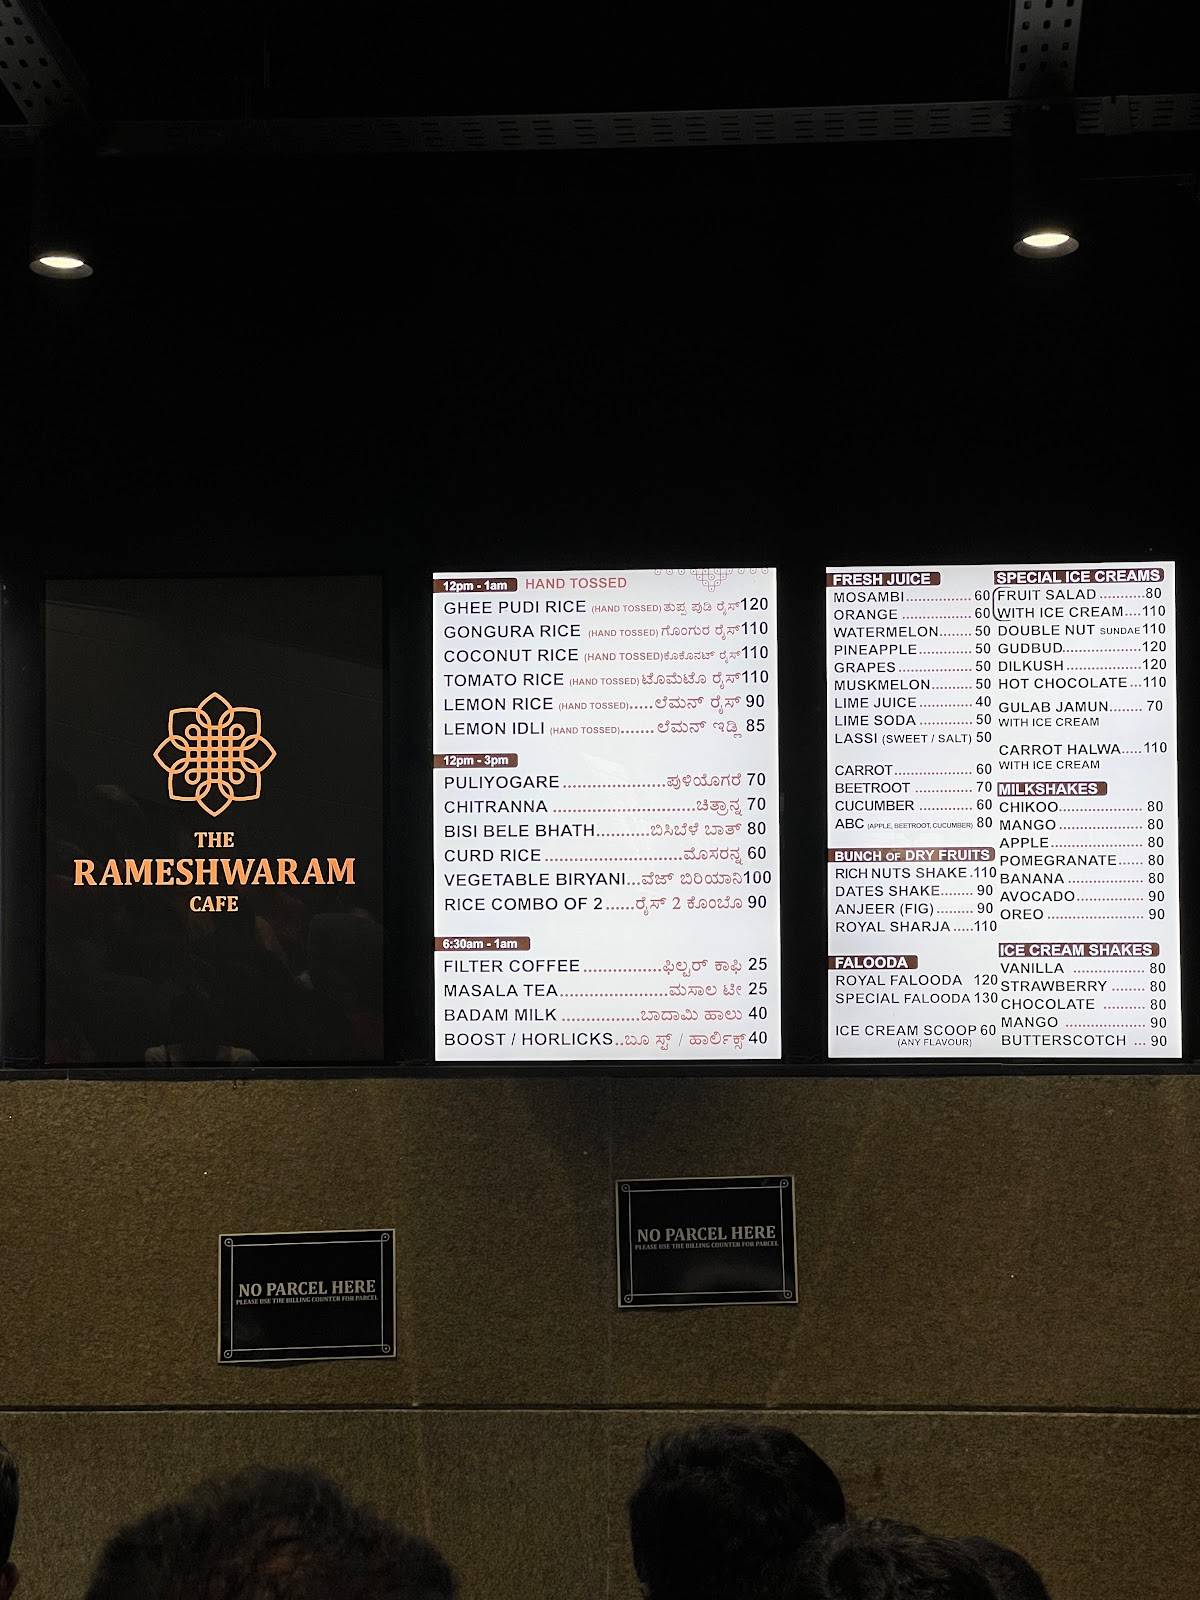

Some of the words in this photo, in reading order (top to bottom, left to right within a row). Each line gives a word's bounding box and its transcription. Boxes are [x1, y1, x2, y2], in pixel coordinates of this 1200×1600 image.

[833, 573, 883, 586] FRESH
[886, 573, 931, 585] JUICE
[996, 571, 1062, 583] SPECIAL
[1065, 571, 1090, 583] ICE
[1094, 570, 1161, 582] CREAMS
[443, 580, 474, 592] 12pm
[484, 580, 508, 592] 1am
[526, 578, 565, 590] HAND
[570, 578, 626, 589] TOSSED
[834, 592, 903, 603] MOSAMBI
[975, 590, 990, 601] 60
[997, 588, 1040, 601] FRUIT
[1046, 589, 1096, 601] SALAD
[1146, 588, 1161, 599] 80
[444, 602, 492, 615] GHEE
[499, 601, 538, 614] PUDI
[546, 601, 586, 613] RICE
[741, 598, 768, 611] 120
[444, 625, 534, 639] GONGURA
[541, 625, 580, 638] RICE
[742, 622, 768, 635] 110
[834, 627, 938, 638] WATERMELON
[975, 626, 990, 637] 50
[999, 625, 1060, 637] DOUBLE
[1066, 625, 1095, 636] NUT
[1100, 627, 1140, 635] SUNDAE
[1143, 623, 1165, 635] 110
[998, 643, 1064, 654] GUDBUD
[1143, 641, 1166, 652] 120
[445, 698, 505, 711] LEMON
[513, 698, 553, 711] RICE
[590, 702, 631, 710] TOSSED)
[746, 695, 764, 708] 90
[835, 698, 868, 709] LIME
[874, 697, 916, 709] JUICE
[976, 696, 991, 707] 40
[999, 702, 1050, 713] GULAB
[1056, 702, 1111, 713] JAMUN
[1147, 700, 1162, 712] 70
[998, 719, 1028, 728] WITH
[1033, 718, 1051, 727] ICE
[1056, 718, 1099, 727] CREAM
[835, 733, 876, 744] LASSI
[882, 733, 928, 745] (SWEET
[938, 733, 972, 744] SALT)
[977, 732, 991, 743] 50
[443, 755, 474, 766] 12pm
[484, 755, 509, 766] 3pm
[445, 776, 559, 790] PULIYOGARE
[747, 773, 765, 786] 70
[836, 783, 910, 794] BEETROOT
[977, 782, 992, 793] 70
[999, 783, 1098, 796] MILKSHAKES
[445, 800, 547, 814] CHITRANNA
[748, 798, 765, 811] 70
[1000, 802, 1060, 813] CHIKOO
[1148, 801, 1163, 812] 80
[835, 819, 864, 829] ABC
[977, 817, 992, 828] 80
[445, 825, 476, 838] BISI
[484, 825, 528, 838] BELE
[536, 824, 594, 837] BHATH
[748, 822, 766, 835] 80
[194, 832, 234, 847] THE
[834, 850, 882, 862] BUNCH
[904, 849, 936, 862] DRY
[939, 849, 990, 861] FRUITS
[1001, 855, 1116, 867] POMEGRANATE
[1148, 855, 1164, 866] 80
[74, 858, 355, 885] RAMESHWARAM
[836, 868, 867, 879] RICH
[872, 868, 910, 879] NUTS
[916, 868, 967, 879] SHAKE
[974, 867, 996, 879] 110
[444, 874, 549, 887] VEGETABLE
[557, 873, 624, 886] BIRYANI
[744, 871, 771, 884] 100
[190, 896, 238, 911] CAFE
[835, 904, 894, 915] ANJEER
[899, 902, 934, 917] (FIG)
[978, 903, 993, 914] 90
[1000, 909, 1043, 920] OREO
[1149, 909, 1164, 920] 90
[442, 938, 483, 950] 6:30am
[494, 938, 518, 950] 1am
[1000, 944, 1026, 958] ICE
[1029, 944, 1085, 957] CREAM
[1088, 943, 1152, 957] SHAKES
[445, 960, 503, 973] FILTER
[510, 960, 579, 973] COFFEE
[749, 958, 767, 971] 25
[834, 956, 908, 969] FALOODA
[1001, 963, 1064, 974] VANILLA
[1150, 963, 1165, 974] 80
[445, 985, 518, 997] MASALA
[523, 984, 558, 997] TEA
[749, 982, 767, 996] 25
[1001, 981, 1107, 992] STRAWBERRY
[1151, 981, 1166, 993] 80
[836, 993, 899, 1004] SPECIAL
[905, 994, 970, 1004] FALOODA
[975, 992, 998, 1004] 130
[445, 1009, 507, 1022] BADAM
[515, 1009, 556, 1022] MILK
[749, 1007, 767, 1020] 40
[836, 1026, 859, 1036] ICE
[865, 1025, 918, 1036] CREAM
[924, 1025, 976, 1036] SCOOP
[981, 1025, 996, 1036] 60
[445, 1033, 506, 1046] BOOST
[523, 1033, 612, 1046] HORLICKS
[749, 1031, 767, 1045] 40
[897, 1037, 921, 1047] (ANY
[923, 1037, 972, 1047] FLAVOUR)
[1002, 1035, 1125, 1046] BUTTERSCOTCH
[1151, 1036, 1167, 1047] 90
[638, 1229, 660, 1242] NO
[666, 1227, 727, 1241] PARCEL
[732, 1226, 775, 1239] HERE
[239, 1284, 262, 1297] NO
[267, 1281, 327, 1296] PARCEL
[332, 1280, 375, 1294] HERE
